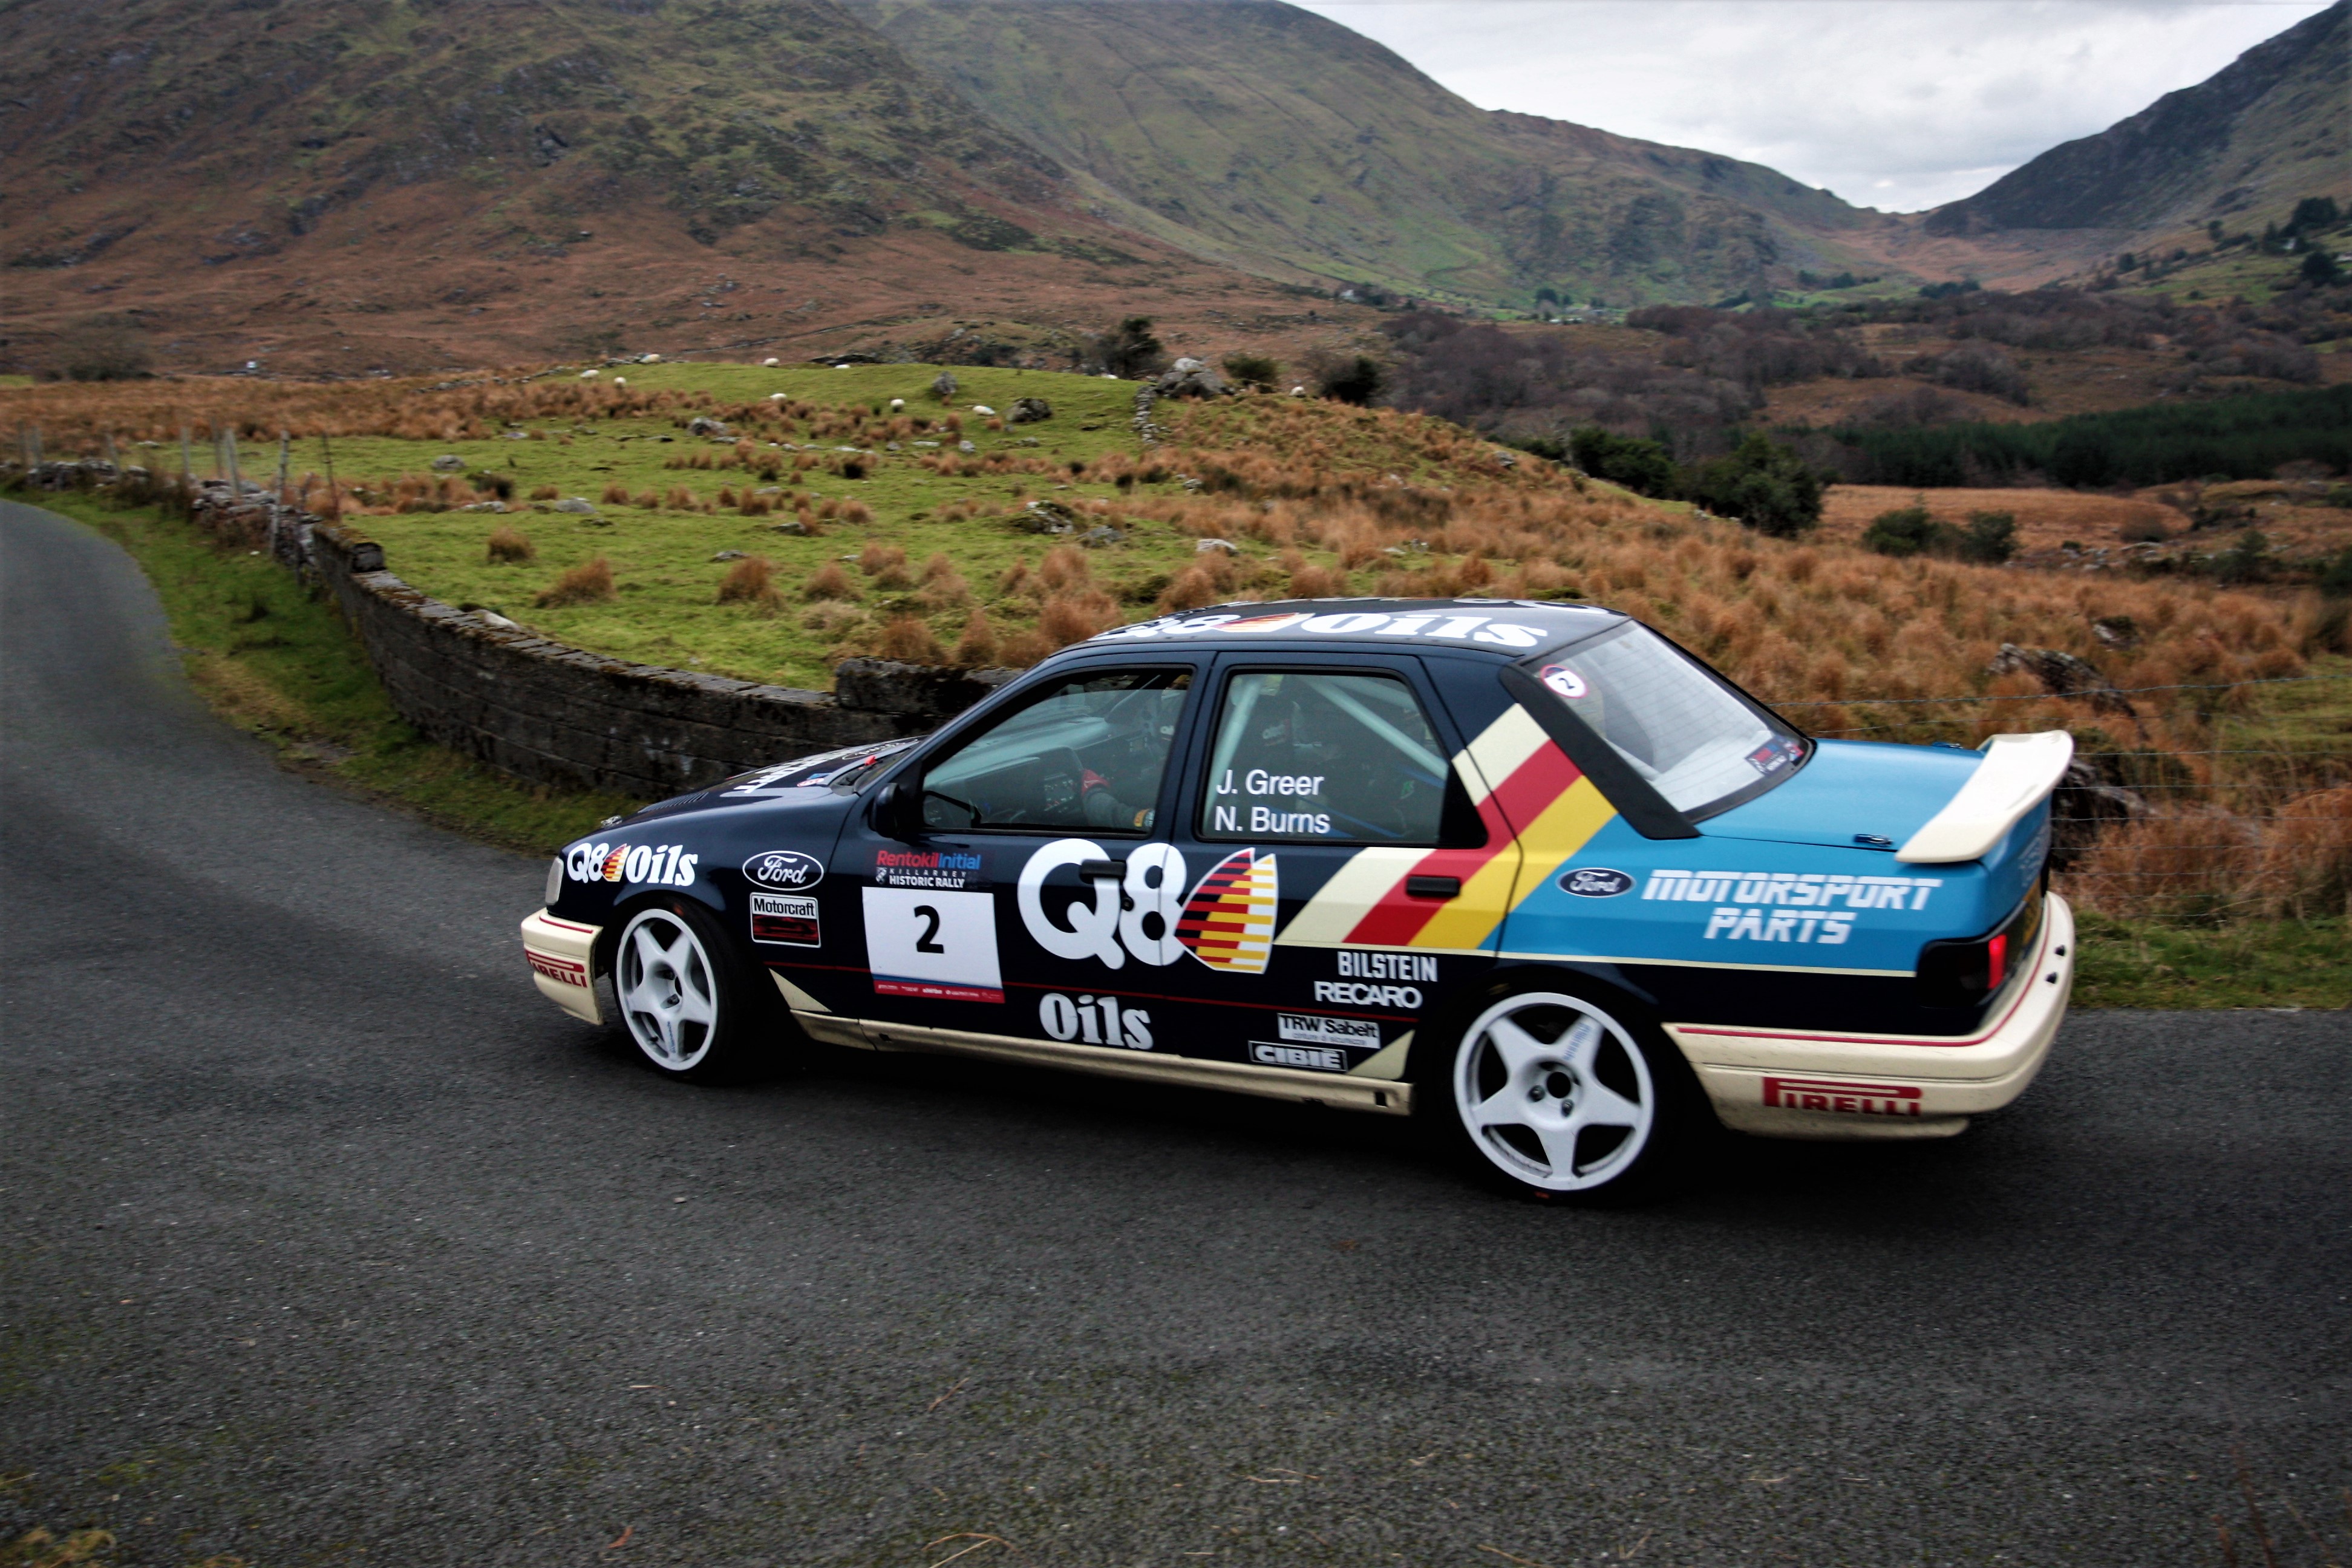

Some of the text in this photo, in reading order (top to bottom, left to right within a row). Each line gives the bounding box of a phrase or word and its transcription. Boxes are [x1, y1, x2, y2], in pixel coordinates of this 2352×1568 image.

[1301, 613, 1548, 647] Oils
[1216, 769, 1324, 796] J. Greer
[1214, 805, 1330, 835] N. Burns
[567, 843, 698, 886] Q8 Oils
[757, 855, 809, 884] Ford
[889, 868, 967, 877] KILLARNEY
[889, 875, 965, 888] HISTORIC RALLY
[1569, 871, 1622, 893] Ford
[1641, 869, 1944, 910] MOTORSPORT
[754, 898, 815, 916] Motorcraft
[1018, 838, 1186, 970] Q8
[913, 905, 945, 954] 2
[1703, 907, 1857, 944] PARTS
[1338, 951, 1438, 982] BILSTEIN
[1314, 981, 1423, 1009] RECARO
[1039, 993, 1154, 1050] Oils
[1281, 1015, 1377, 1037] TRW Sabelt
[1763, 1077, 1924, 1116] PIRELLI
